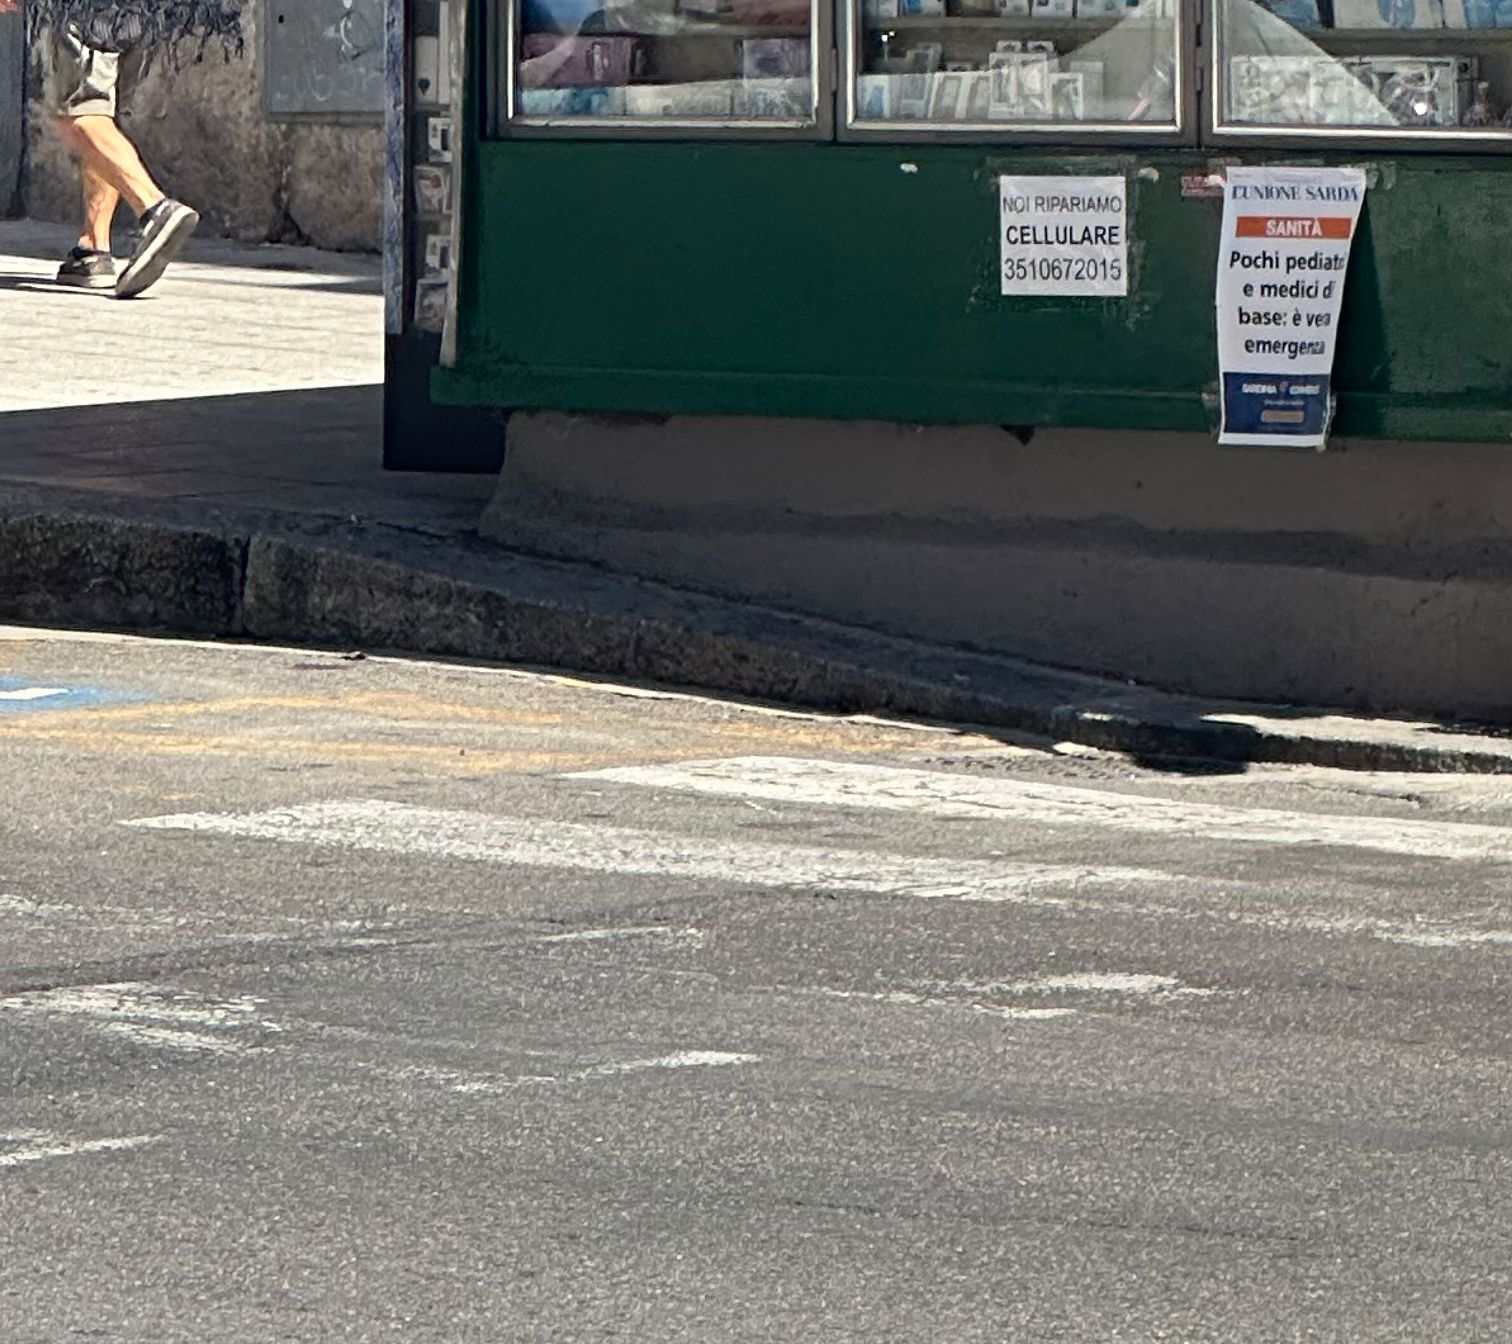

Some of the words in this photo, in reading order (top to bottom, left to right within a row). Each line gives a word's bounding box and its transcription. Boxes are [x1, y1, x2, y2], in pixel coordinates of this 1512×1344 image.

[1305, 185, 1359, 201] SARDA
[1002, 196, 1030, 213] NOI
[1034, 195, 1123, 213] RIPARIAMO
[1006, 225, 1120, 245] CELLULARE
[1265, 218, 1322, 237] SANITÀ
[1004, 257, 1122, 281] 3510672015
[1229, 250, 1280, 270] Pochi
[1242, 283, 1254, 297] e
[1259, 279, 1319, 298] medici
[1238, 305, 1288, 326] base:
[1292, 307, 1302, 327] è
